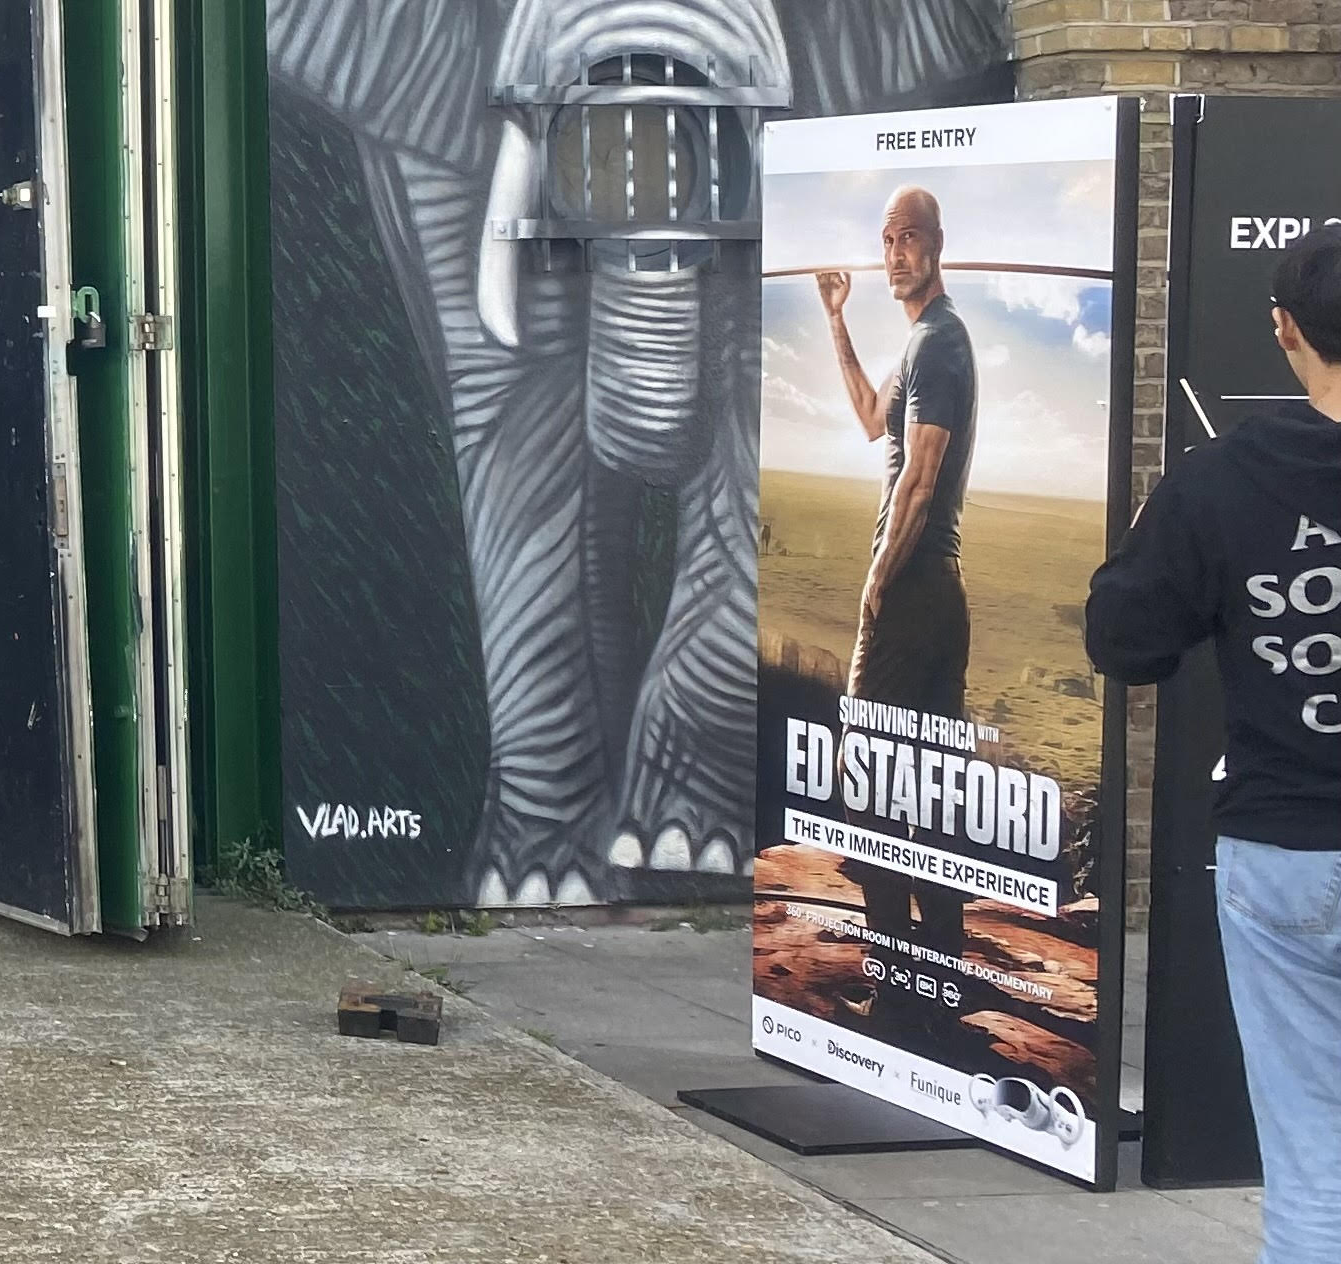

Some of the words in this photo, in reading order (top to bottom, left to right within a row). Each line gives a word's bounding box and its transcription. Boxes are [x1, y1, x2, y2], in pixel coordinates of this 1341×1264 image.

[876, 131, 917, 151] FREE
[921, 127, 977, 148] ENTRY
[839, 695, 918, 739] SURVIVING
[920, 712, 977, 753] AFRICA
[977, 724, 1000, 744] WITH
[785, 717, 834, 802] ED
[842, 731, 1062, 862] STAFFORD
[792, 816, 821, 840] THE
[824, 825, 845, 849] VR
[848, 834, 938, 874] IMMERSIVE
[941, 859, 1050, 907] EXPERIENCE
[806, 909, 862, 939] PROJECTION
[862, 928, 891, 949] ROOM
[896, 940, 911, 954] VR
[911, 944, 975, 976] INTERACTIVE
[974, 964, 1054, 1001] DOCUMENTARY
[867, 962, 881, 974] VR
[776, 1023, 802, 1042] PICO
[827, 1039, 885, 1077] Discovery
[910, 1071, 962, 1105] Funique
